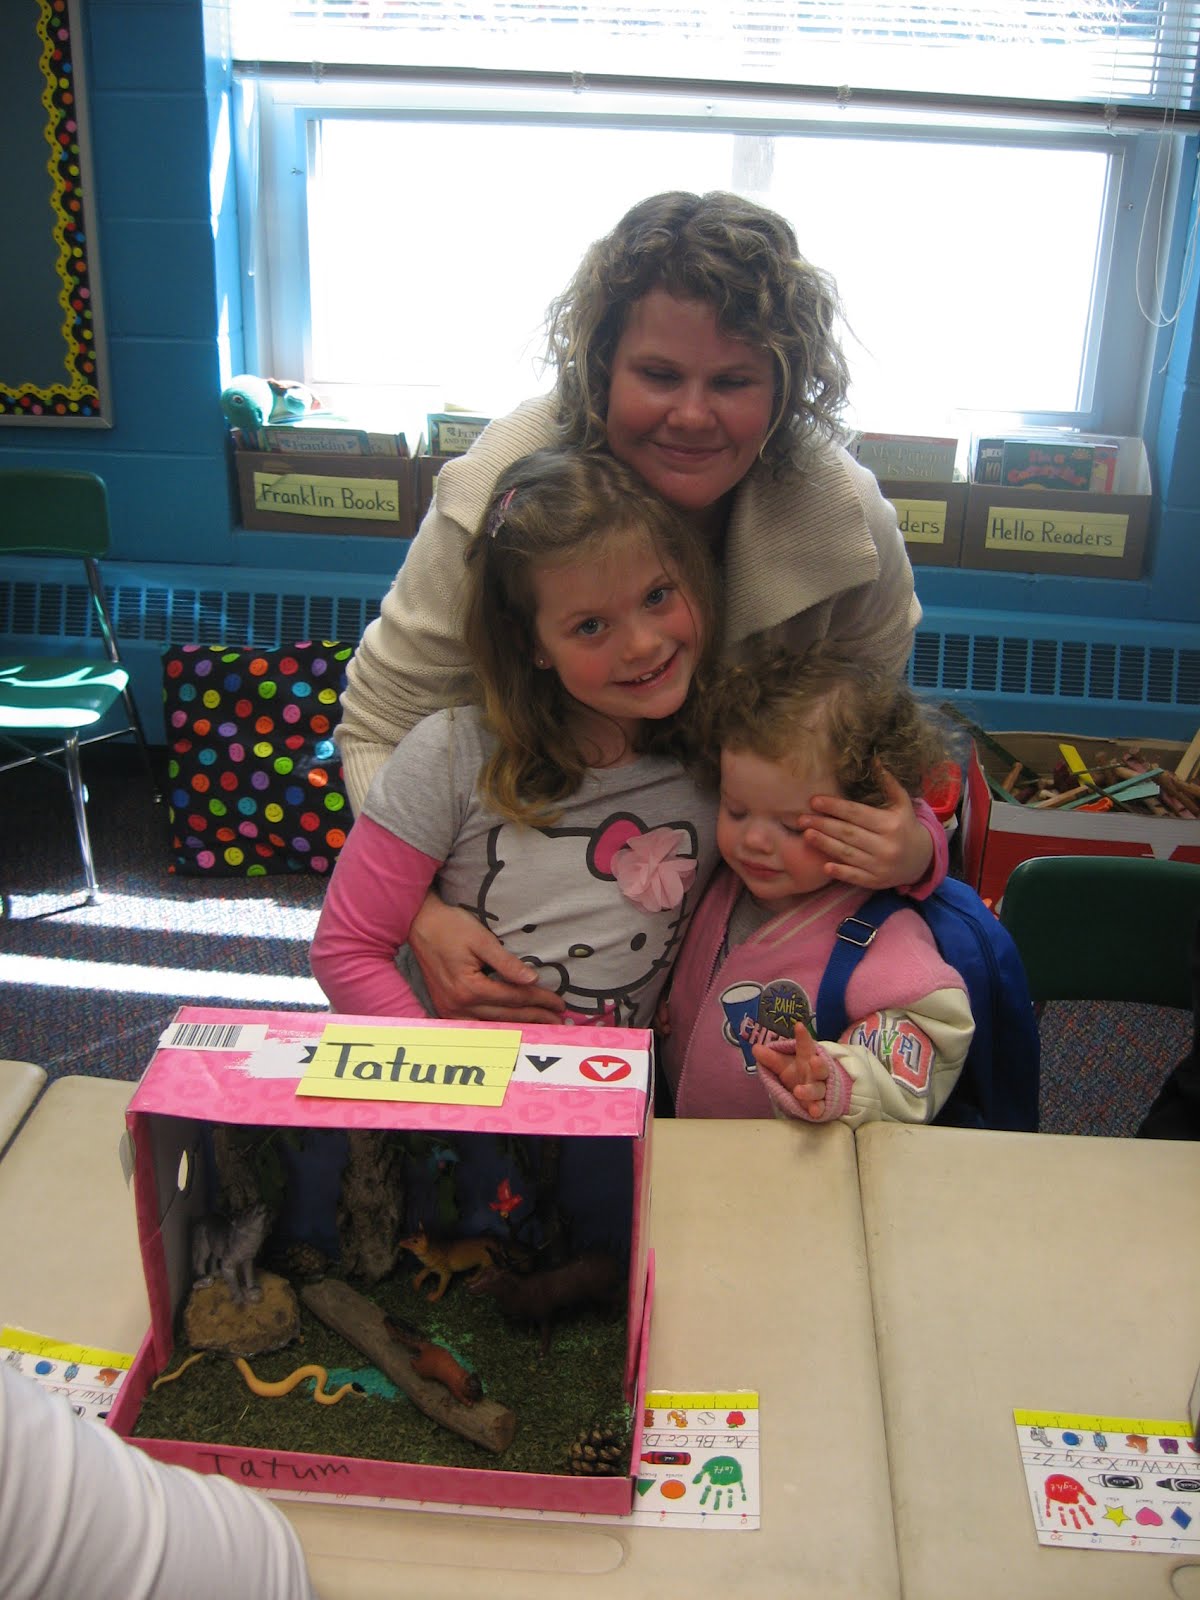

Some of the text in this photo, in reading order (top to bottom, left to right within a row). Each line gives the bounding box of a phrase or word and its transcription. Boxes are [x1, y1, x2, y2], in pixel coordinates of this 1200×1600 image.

[261, 482, 396, 512] Franklin Books
[991, 518, 1113, 546] Hello Readers
[859, 1029, 913, 1056] MVP
[327, 1042, 484, 1086] Tatum
[695, 1435, 716, 1448] Bb
[723, 1435, 749, 1448] Aa
[197, 1452, 350, 1481] Tatum
[1033, 1453, 1055, 1467] Zz
[1065, 1450, 1085, 1468] Yy
[1092, 1457, 1120, 1471] Xx
[1126, 1459, 1162, 1473] Ww
[1165, 1462, 1188, 1475] Vv
[1051, 1483, 1078, 1492] right
